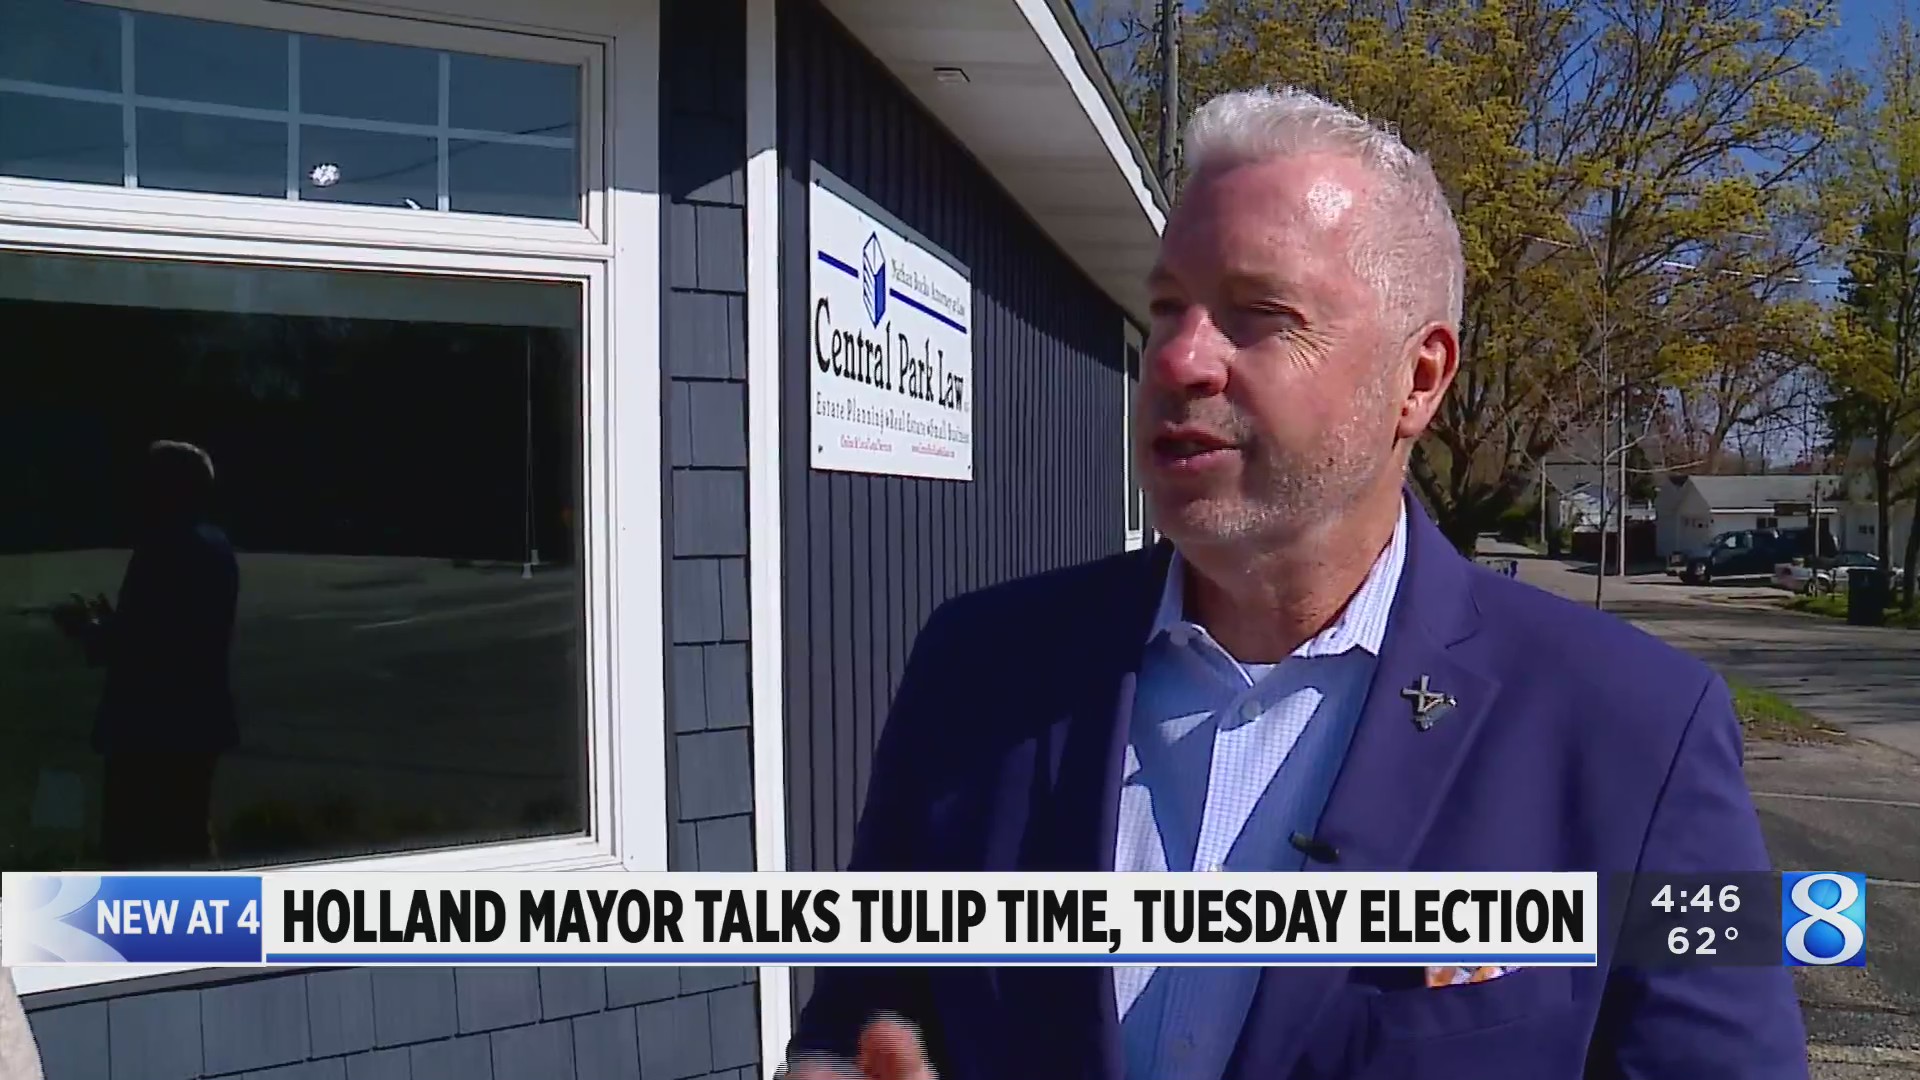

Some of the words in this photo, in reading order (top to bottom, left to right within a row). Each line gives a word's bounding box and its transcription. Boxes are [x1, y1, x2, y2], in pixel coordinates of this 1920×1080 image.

[815, 297, 891, 390] Central
[898, 333, 934, 402] Park
[937, 350, 964, 412] Law
[816, 391, 845, 420] Estate
[847, 396, 883, 434] Planning
